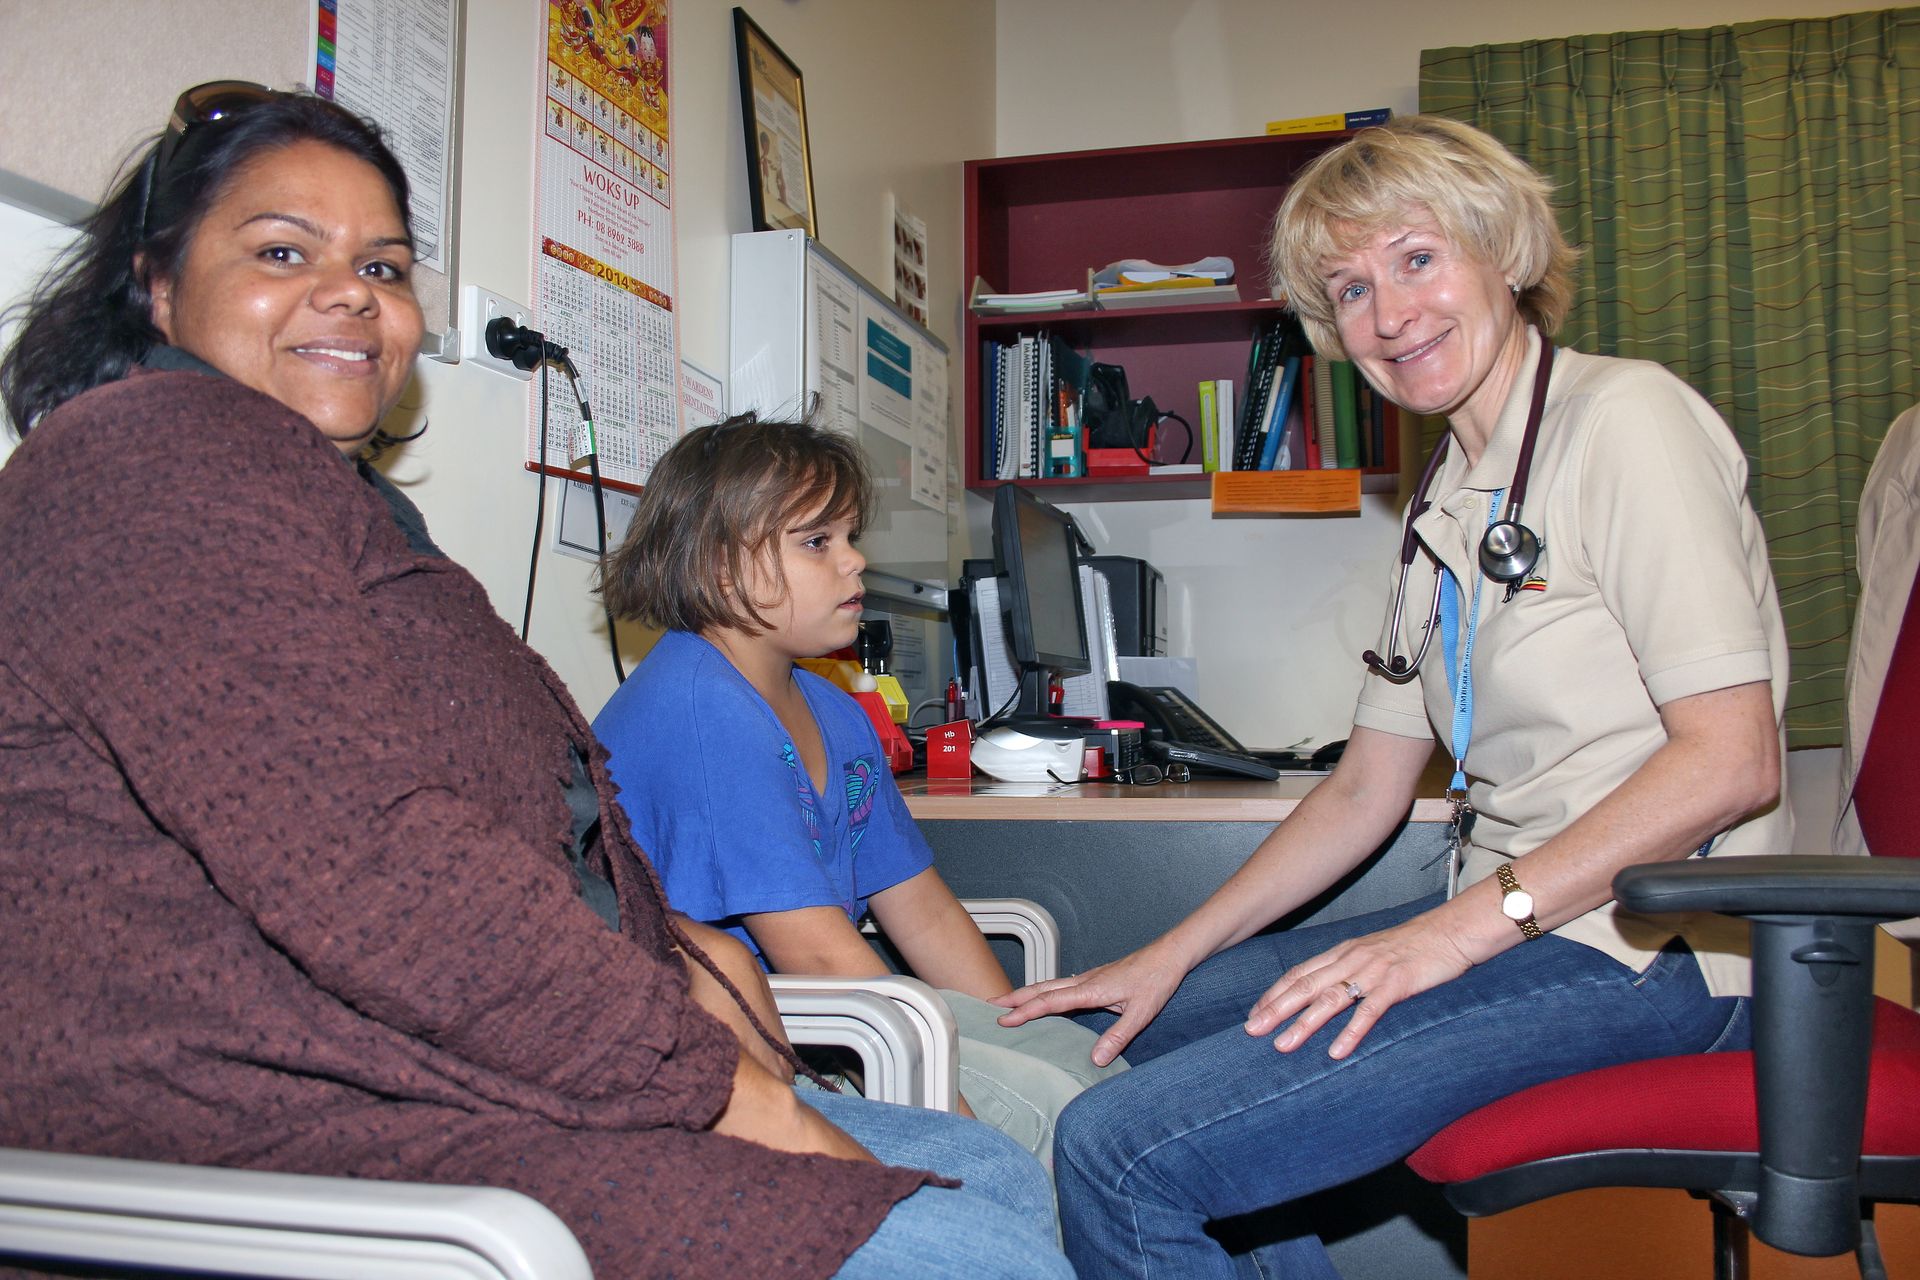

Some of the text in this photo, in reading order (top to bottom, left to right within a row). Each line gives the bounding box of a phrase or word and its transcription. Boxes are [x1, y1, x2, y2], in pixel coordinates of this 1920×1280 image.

[584, 165, 640, 210] WOKS UP
[577, 209, 594, 229] PH:
[596, 220, 606, 234] 08
[607, 226, 625, 245] 8962
[627, 236, 645, 255] 3888
[597, 263, 630, 289] 2014
[685, 375, 714, 400] WARDENS
[1023, 343, 1031, 402] IMMUNISATION
[1459, 661, 1469, 713] KIMBERLEY
[944, 730, 955, 739] Hb
